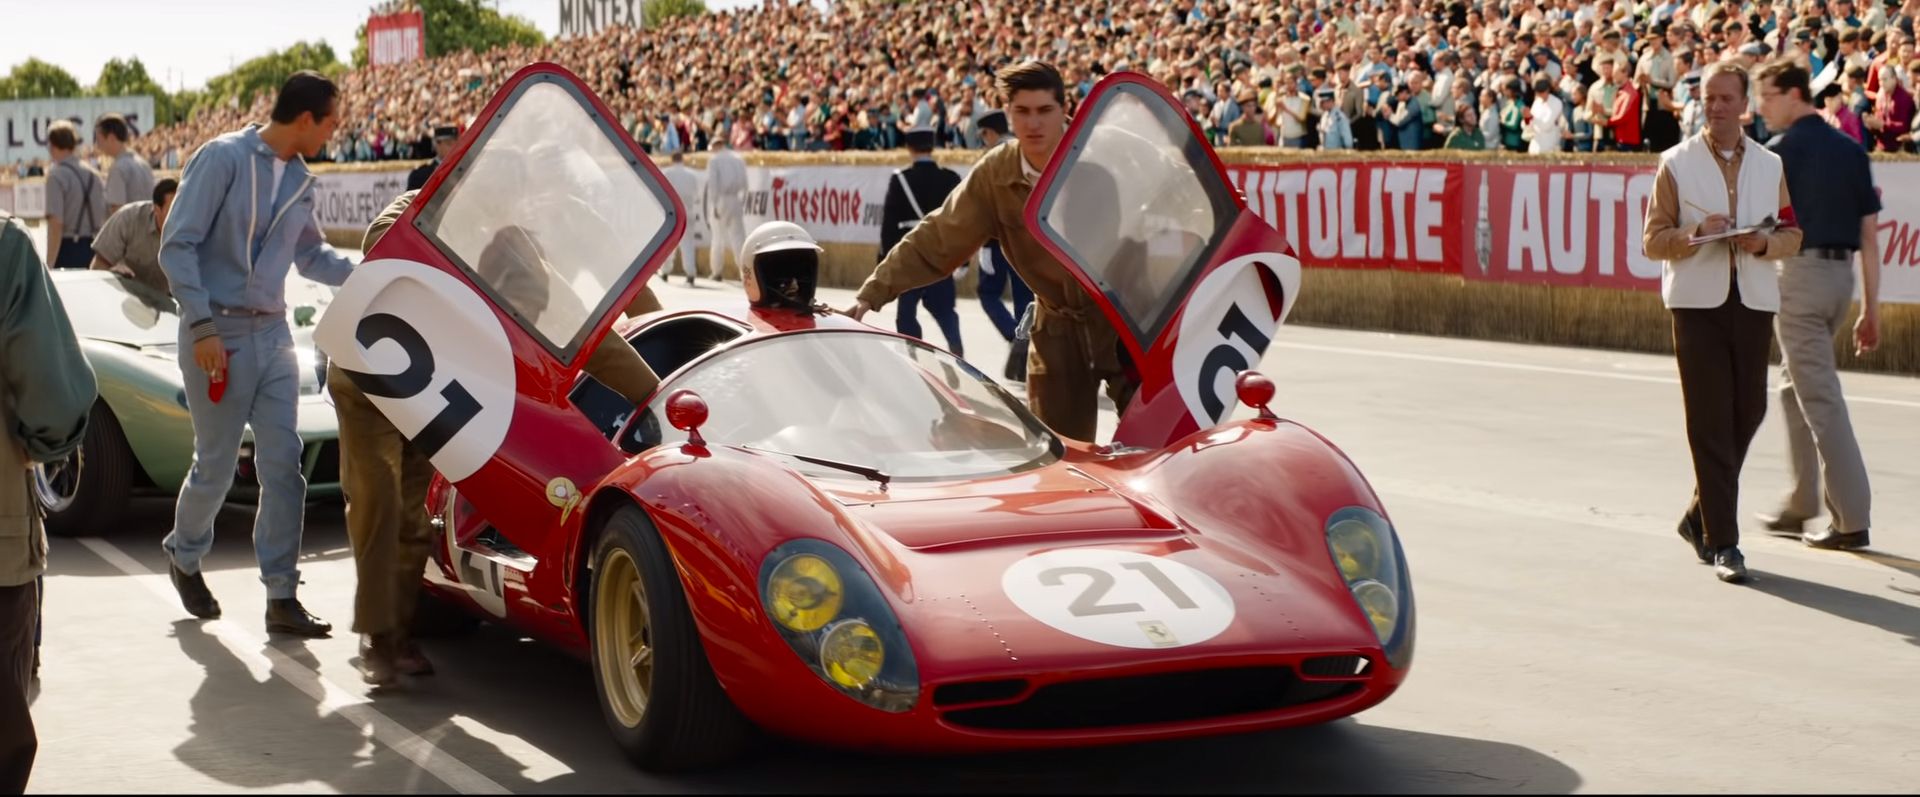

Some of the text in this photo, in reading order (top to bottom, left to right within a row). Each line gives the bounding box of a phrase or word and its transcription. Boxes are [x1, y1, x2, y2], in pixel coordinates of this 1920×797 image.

[771, 177, 861, 225] Firestone
[1228, 168, 1447, 262] UTOLITE
[341, 313, 484, 460] 21
[1036, 561, 1200, 617] 21
